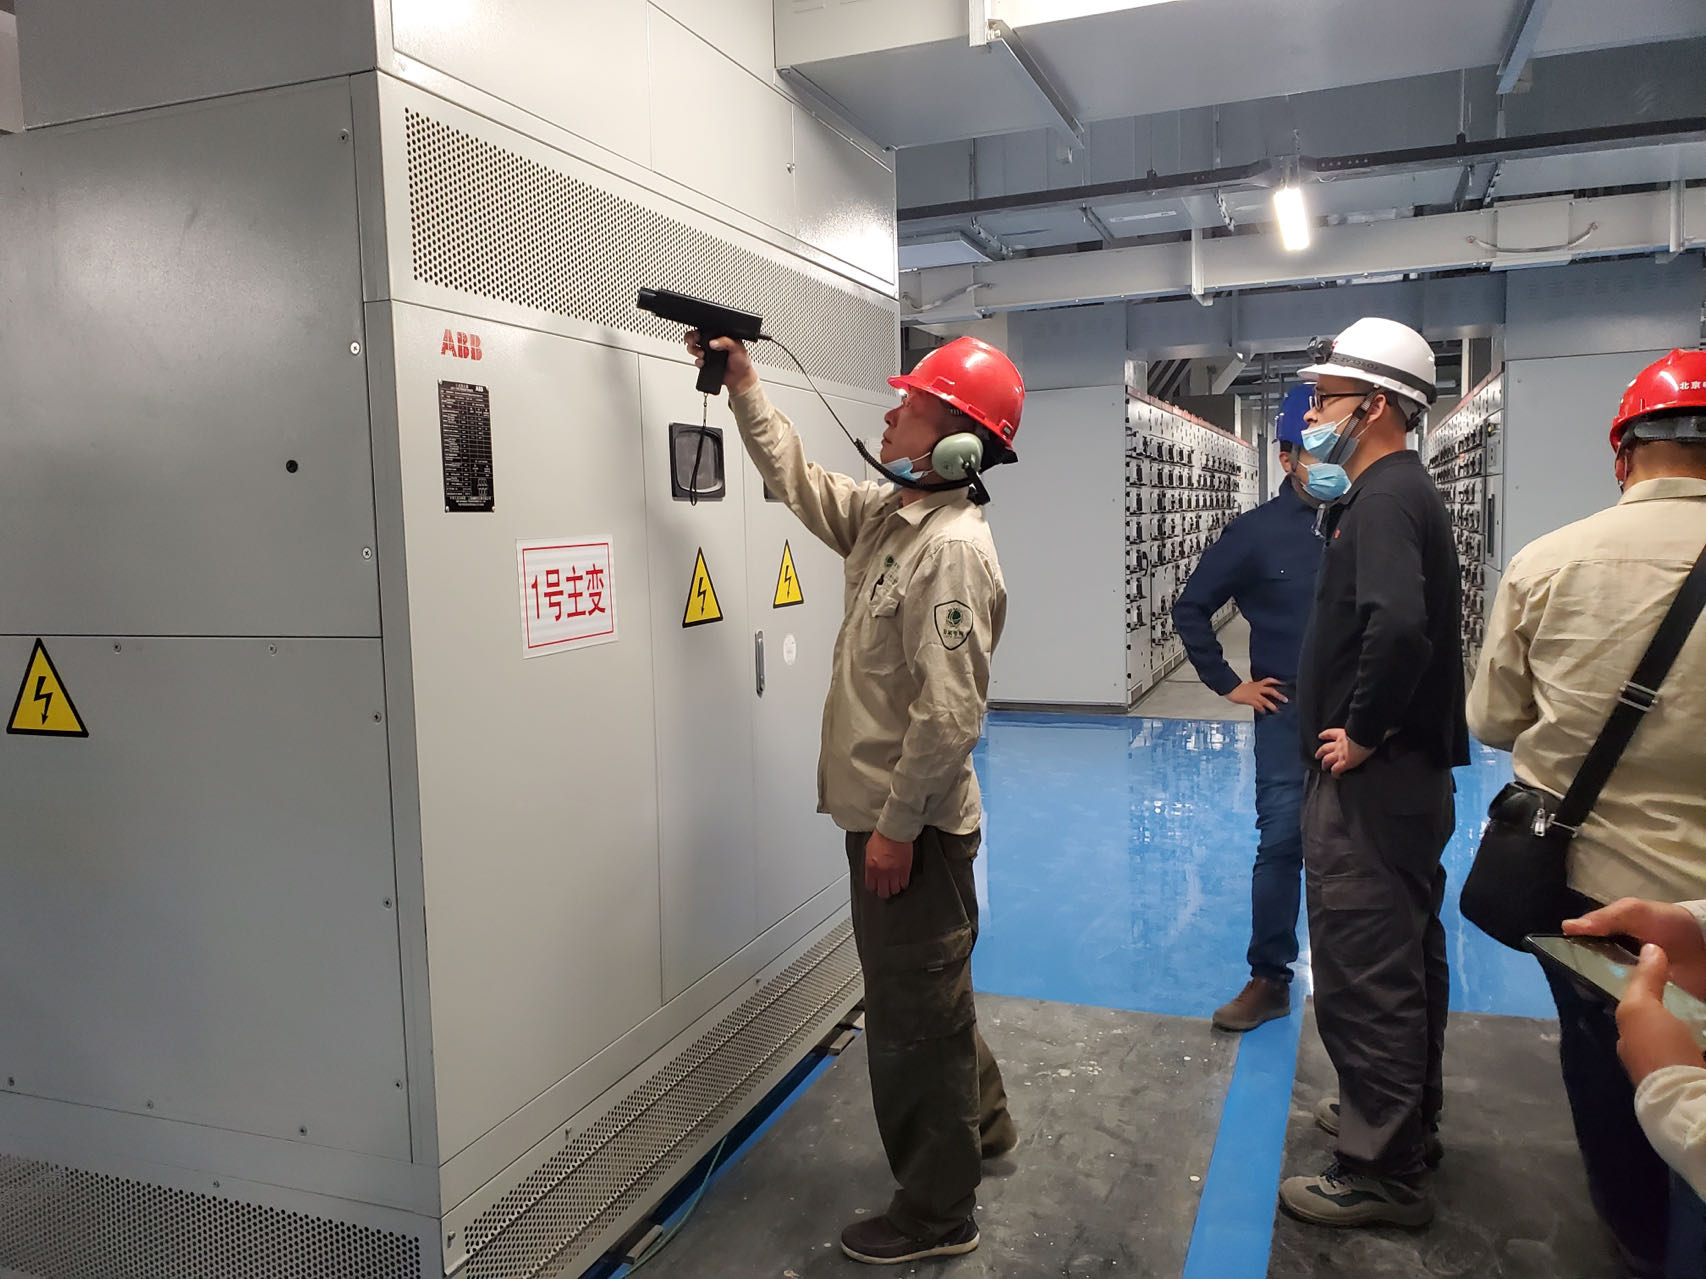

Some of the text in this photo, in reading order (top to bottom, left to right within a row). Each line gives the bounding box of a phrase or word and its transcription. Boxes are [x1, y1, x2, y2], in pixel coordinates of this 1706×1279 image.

[441, 329, 482, 361] ABB
[531, 563, 606, 622] 1号主变
